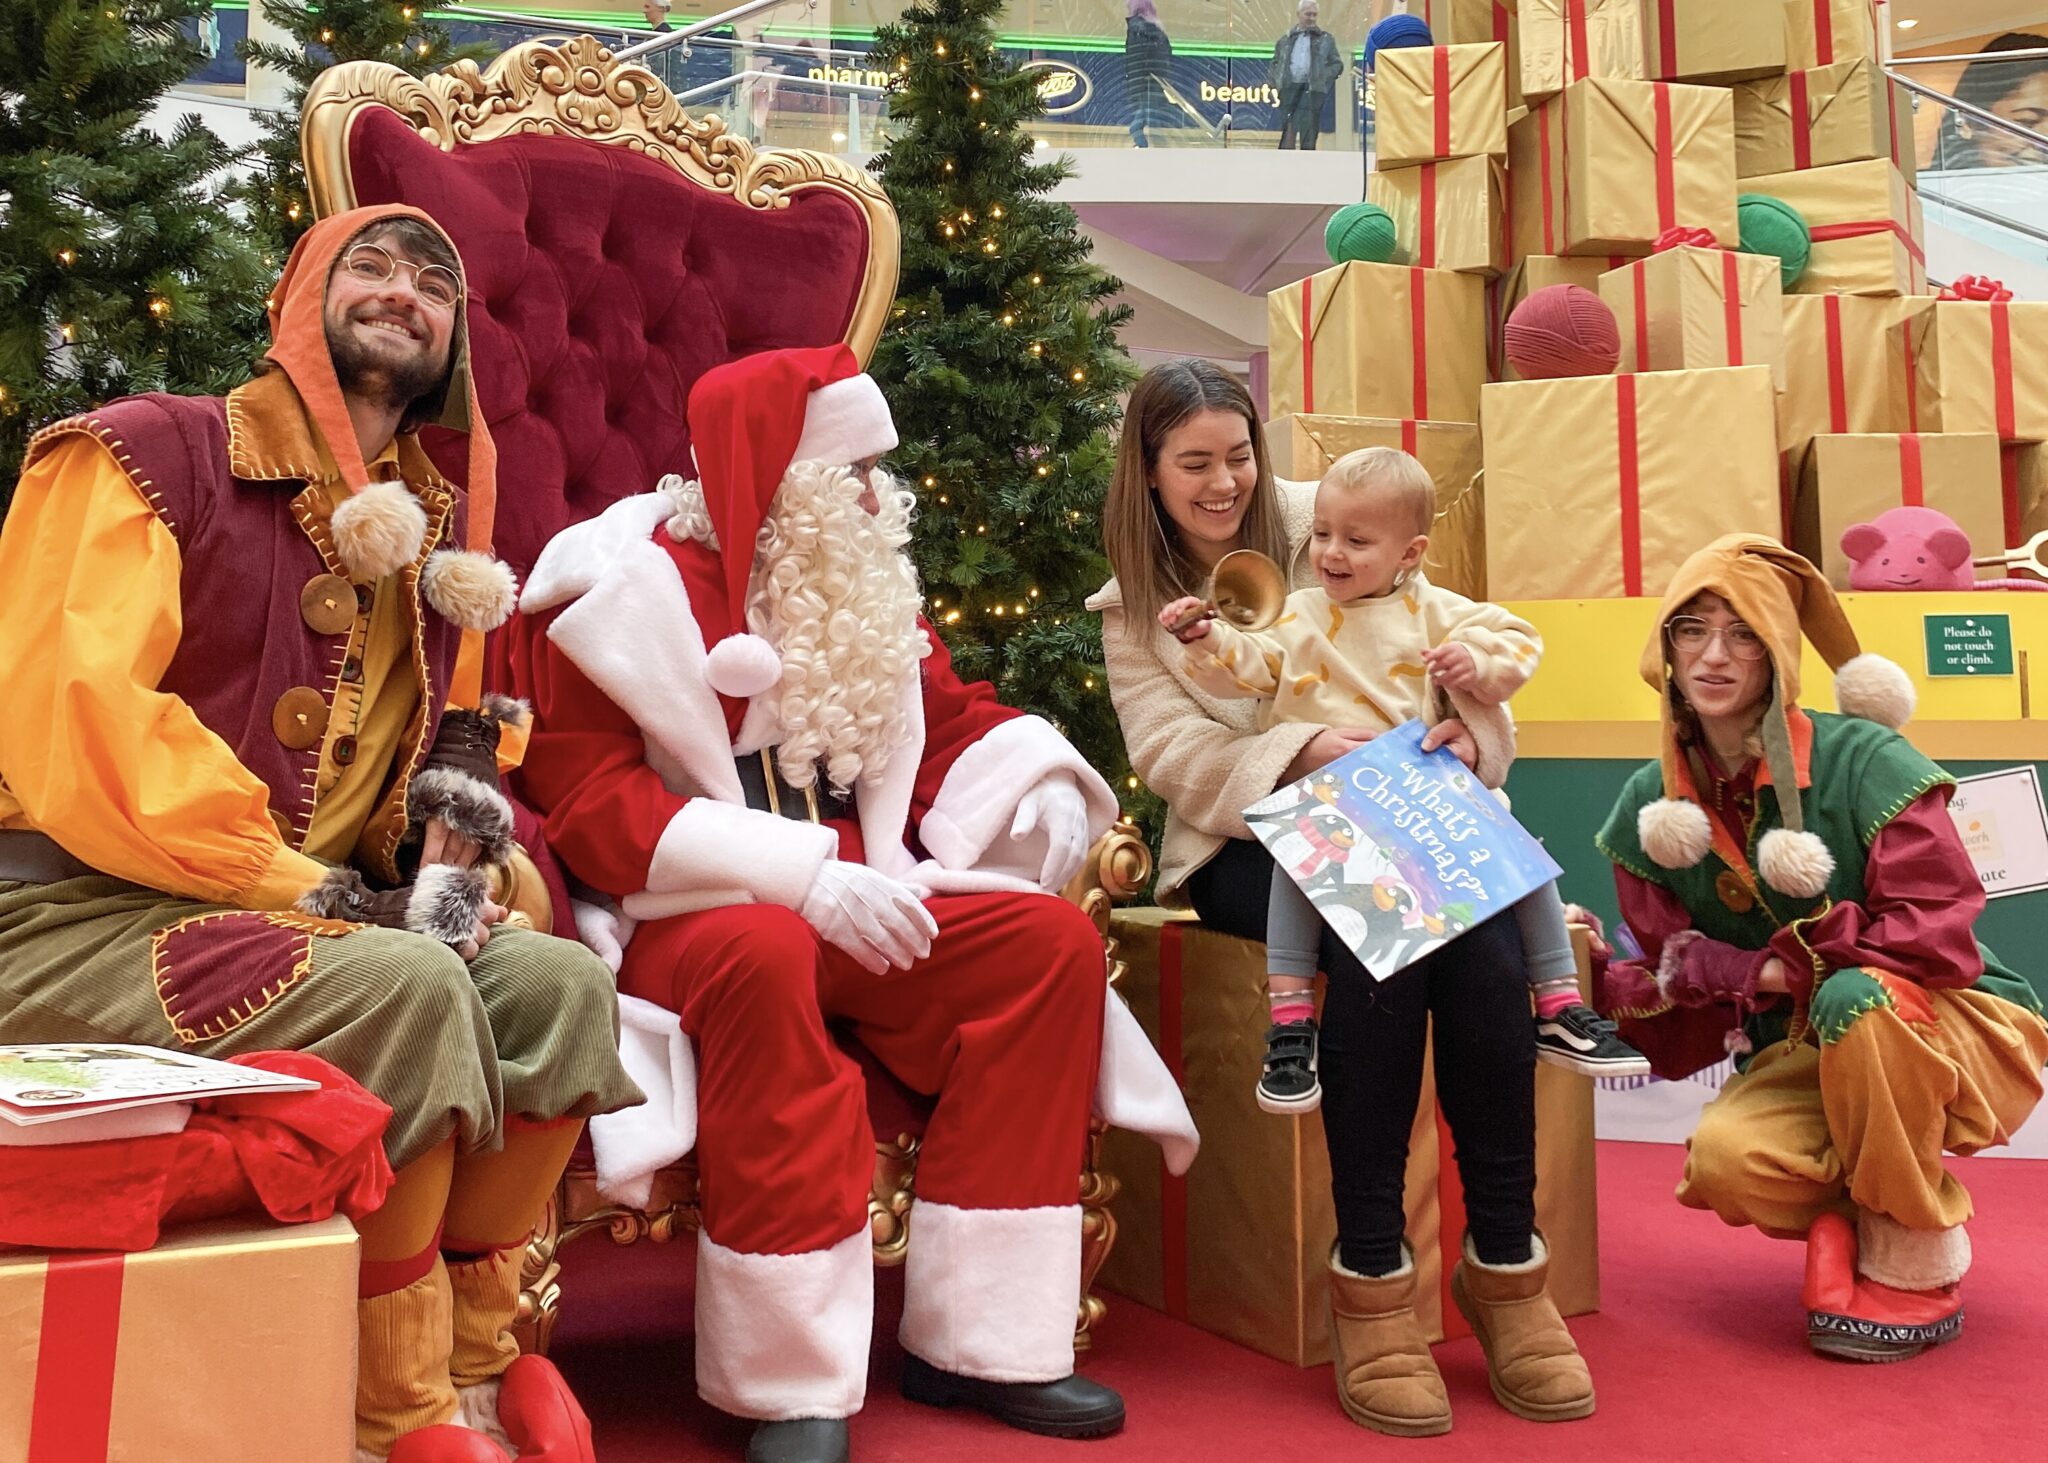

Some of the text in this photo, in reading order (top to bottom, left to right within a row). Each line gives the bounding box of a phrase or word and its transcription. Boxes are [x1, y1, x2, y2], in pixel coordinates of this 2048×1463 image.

[1036, 71, 1077, 99] oots
[1200, 81, 1281, 108] beauty
[1944, 626, 1992, 637] Please do
[1944, 639, 1994, 651] not touch
[1946, 653, 1994, 665] or climb.
[1468, 848, 1491, 868] a
